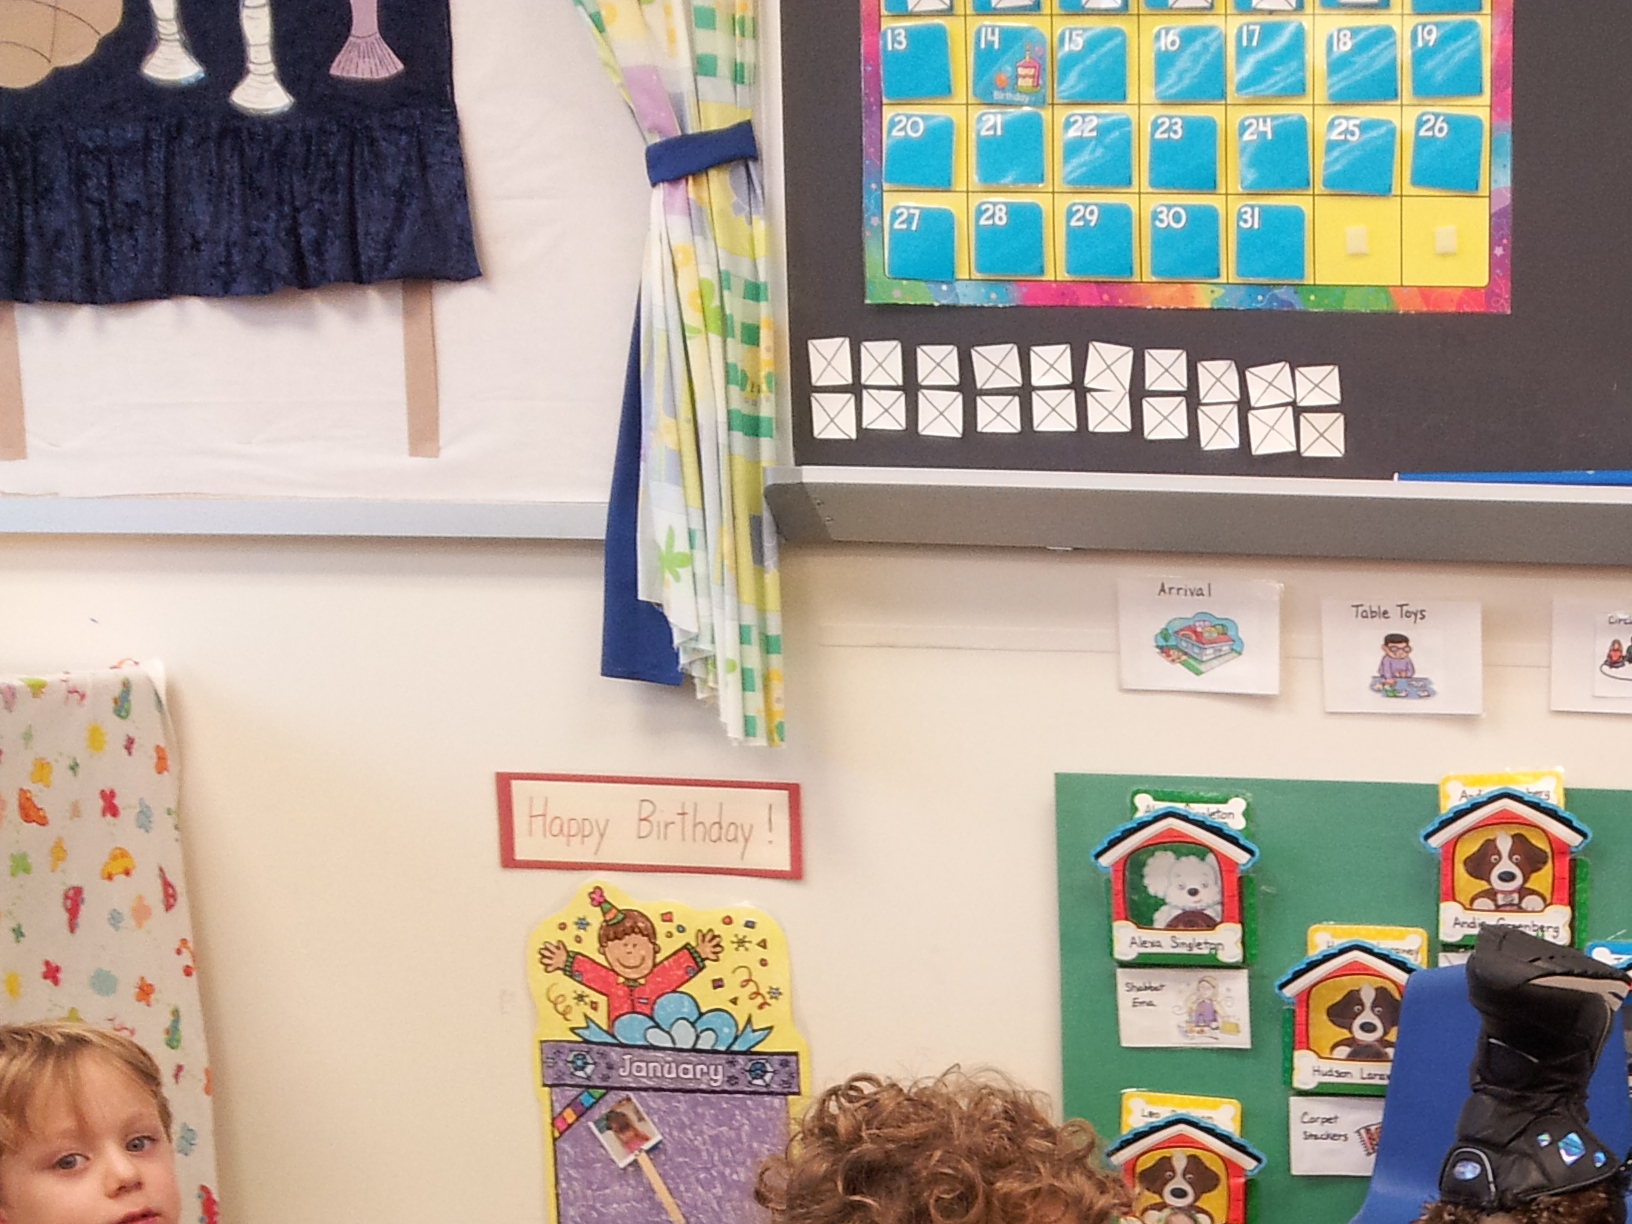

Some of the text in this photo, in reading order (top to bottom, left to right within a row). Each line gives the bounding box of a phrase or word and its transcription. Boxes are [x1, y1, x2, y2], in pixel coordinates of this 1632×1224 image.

[886, 24, 1437, 51] 13 14 15 16 17 18 19
[891, 114, 1449, 142] 20 21 22 23 24 25 26
[893, 203, 1260, 231] 27 28 29 30 31
[1157, 582, 1213, 597] Arrival
[1351, 603, 1427, 624] Table Toys
[527, 796, 610, 855] Happy
[635, 798, 755, 858] Birthday
[1129, 935, 1225, 953] Alexa Singleton
[1124, 981, 1166, 994] Shabbat
[617, 1054, 727, 1087] January
[1312, 1066, 1353, 1078] Hudson
[1141, 1109, 1161, 1119] Leo
[1300, 1111, 1339, 1126] Carpet
